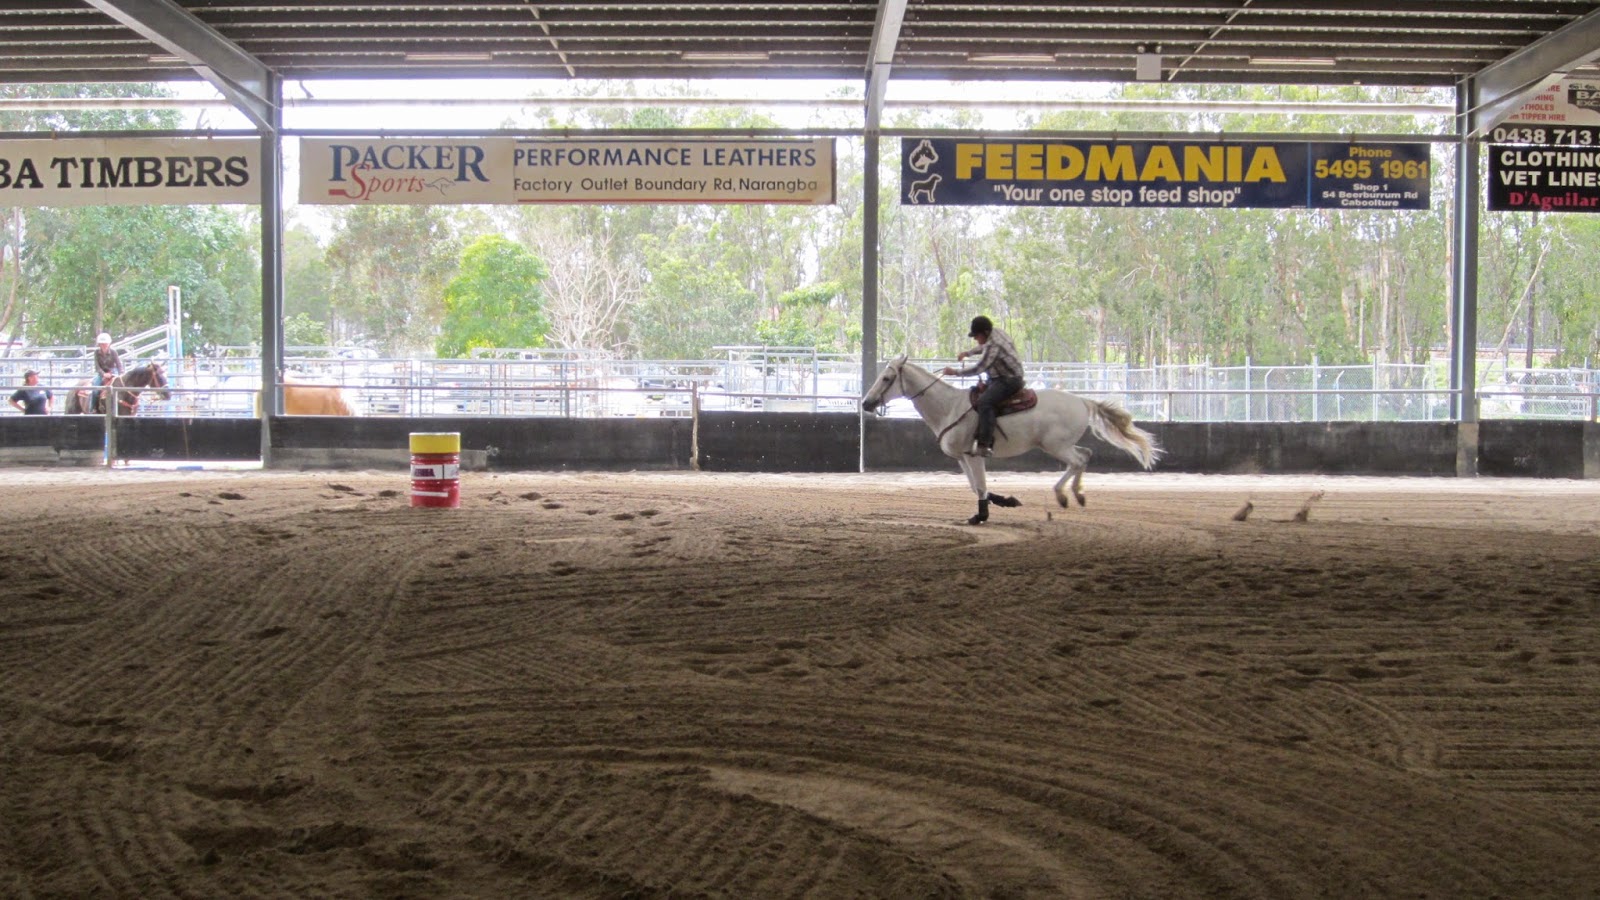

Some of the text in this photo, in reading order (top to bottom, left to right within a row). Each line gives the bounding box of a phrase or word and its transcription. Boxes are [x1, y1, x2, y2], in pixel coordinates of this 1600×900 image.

[1549, 113, 1566, 121] HIRE
[1493, 128, 1546, 143] 0438
[1553, 129, 1592, 145] 713
[513, 148, 817, 166] PERFORMANCE LEATHERS
[1349, 147, 1392, 157] Phone
[50, 156, 249, 188] TIMBERS
[329, 145, 489, 182] PACKER
[956, 143, 1287, 183] FEEDMANIA
[1315, 160, 1427, 179] 5495 1961
[332, 163, 425, 200] Sports
[513, 178, 572, 193] Factory
[581, 178, 628, 191] Outlet
[635, 178, 707, 193] Boundary
[740, 178, 818, 193] Narangba
[1353, 183, 1379, 192] Shop
[1500, 171, 1600, 187] VET LINE
[994, 185, 1241, 206] "Your one stop feed shop"
[1338, 191, 1401, 199] Beerburrum
[1509, 191, 1599, 211] D'Aguilar
